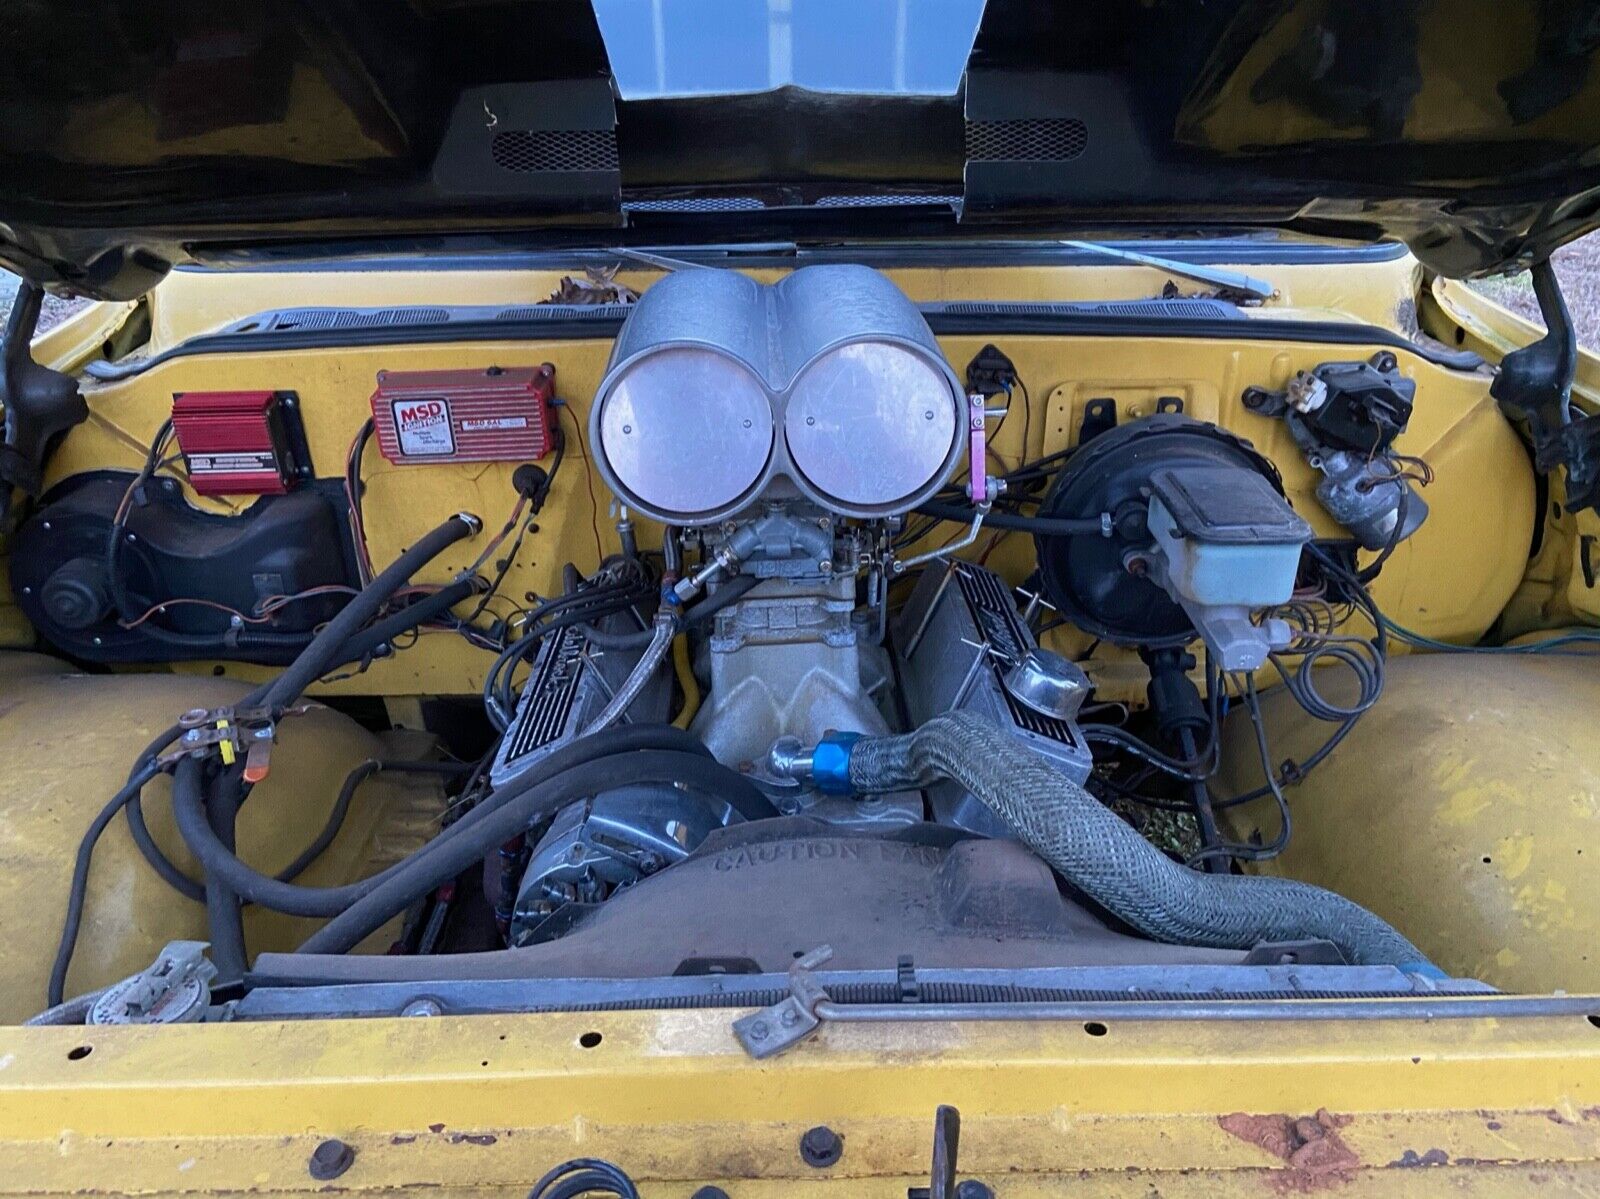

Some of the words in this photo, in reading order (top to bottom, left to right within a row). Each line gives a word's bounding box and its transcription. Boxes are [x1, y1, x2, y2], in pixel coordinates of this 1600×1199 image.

[401, 402, 442, 423] MSD
[402, 414, 444, 432] IGNITION
[712, 842, 859, 872] CAUTION
